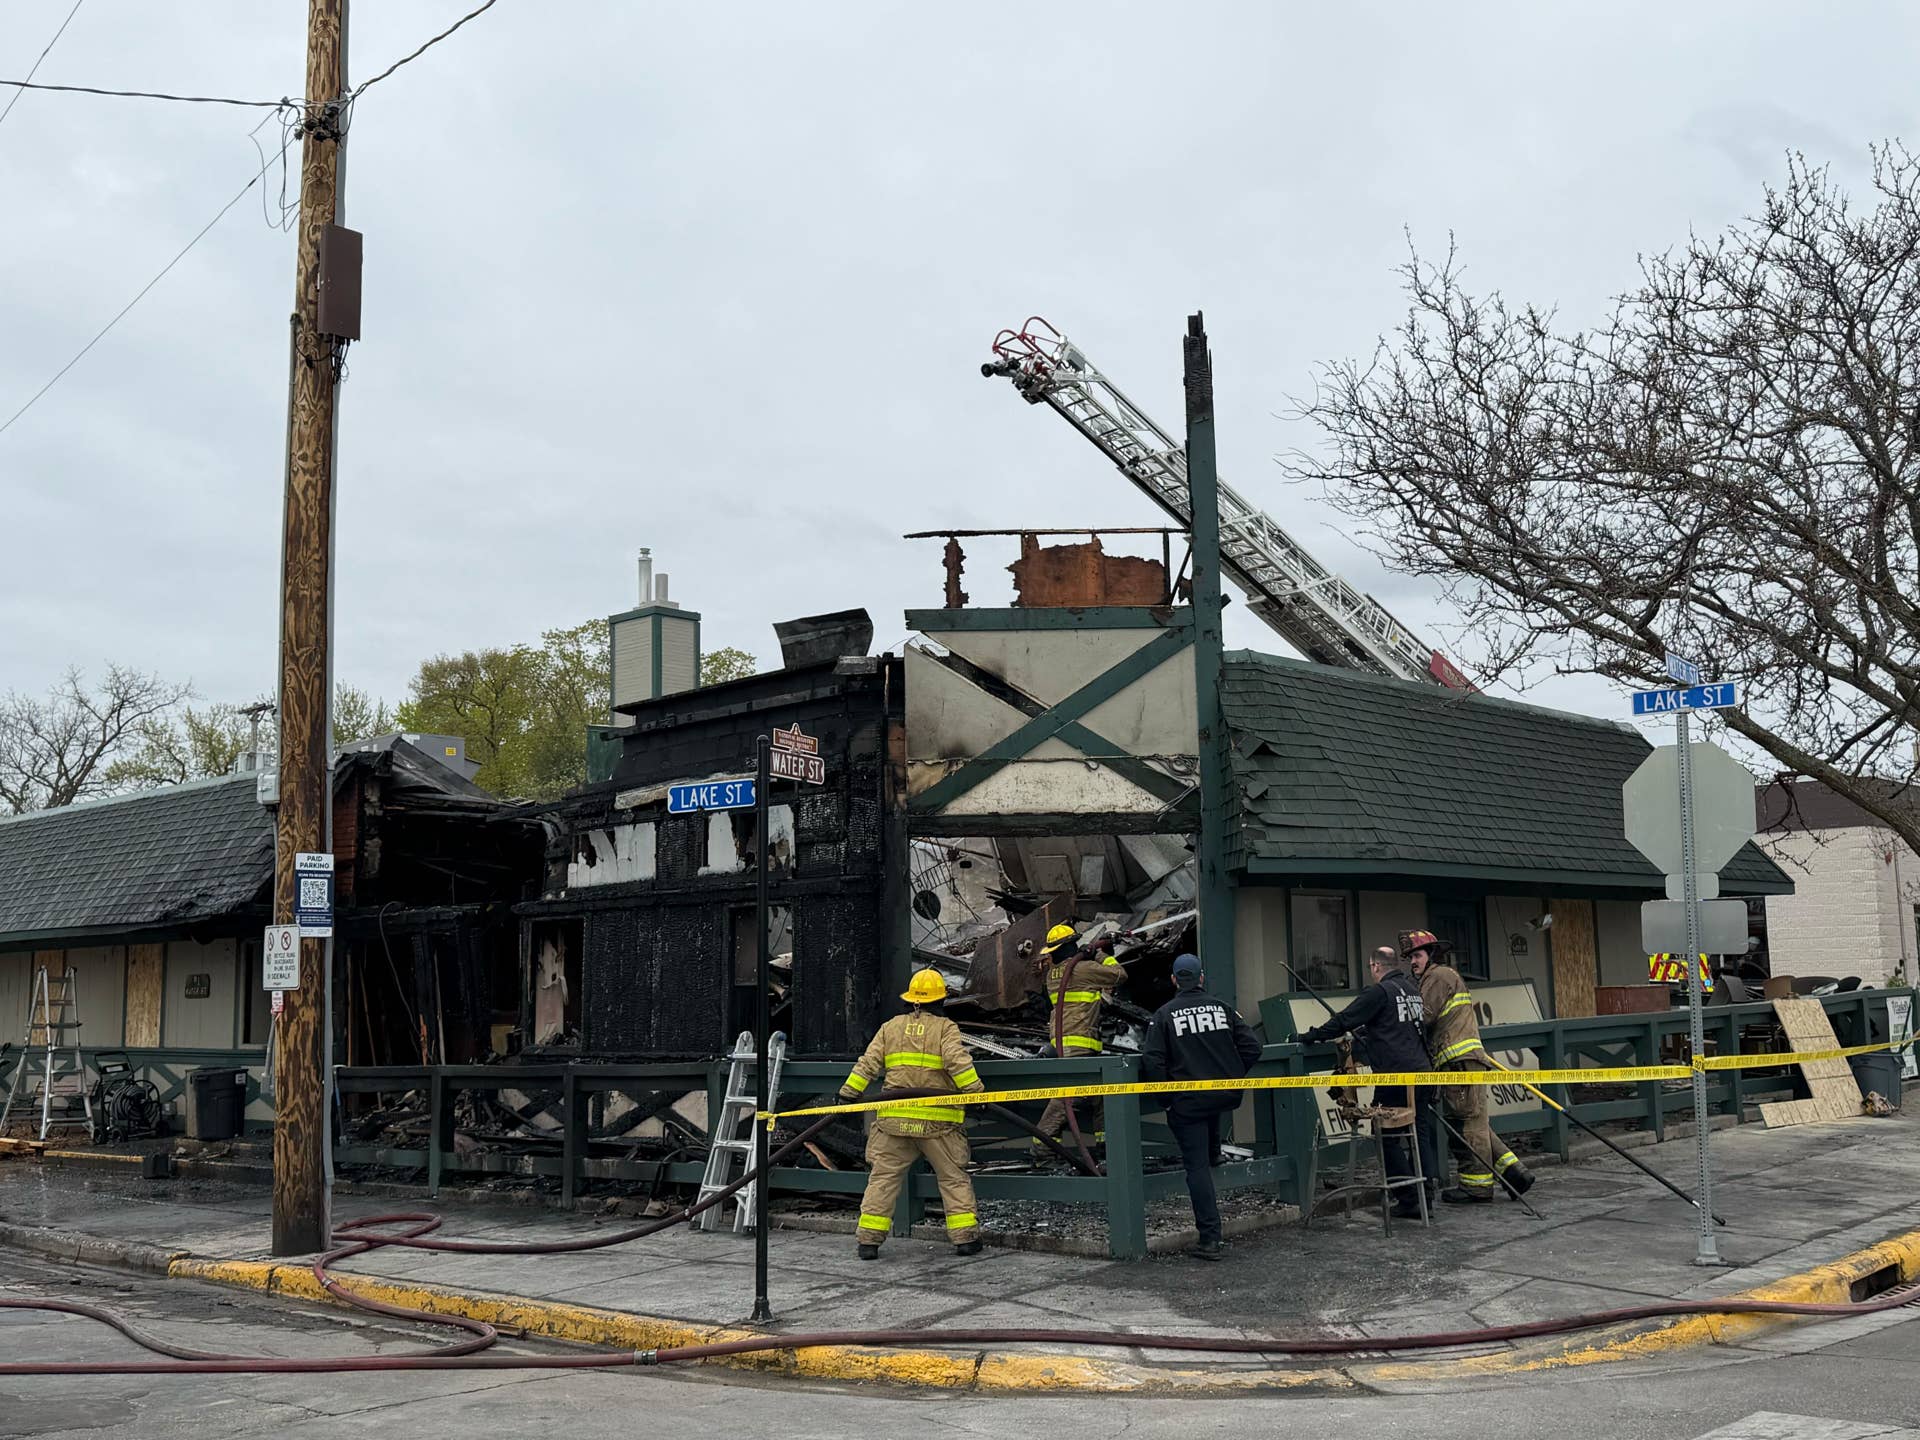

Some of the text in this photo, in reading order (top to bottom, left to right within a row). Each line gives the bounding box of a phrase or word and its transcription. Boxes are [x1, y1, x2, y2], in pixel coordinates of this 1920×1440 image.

[1643, 686, 1724, 712] LAKE ST
[772, 752, 820, 779] WATER ST
[681, 784, 743, 808] LAKE ST
[1171, 1005, 1224, 1018] VICTORIA
[1173, 1012, 1229, 1037] FIRE
[900, 1122, 925, 1134] BROWN
